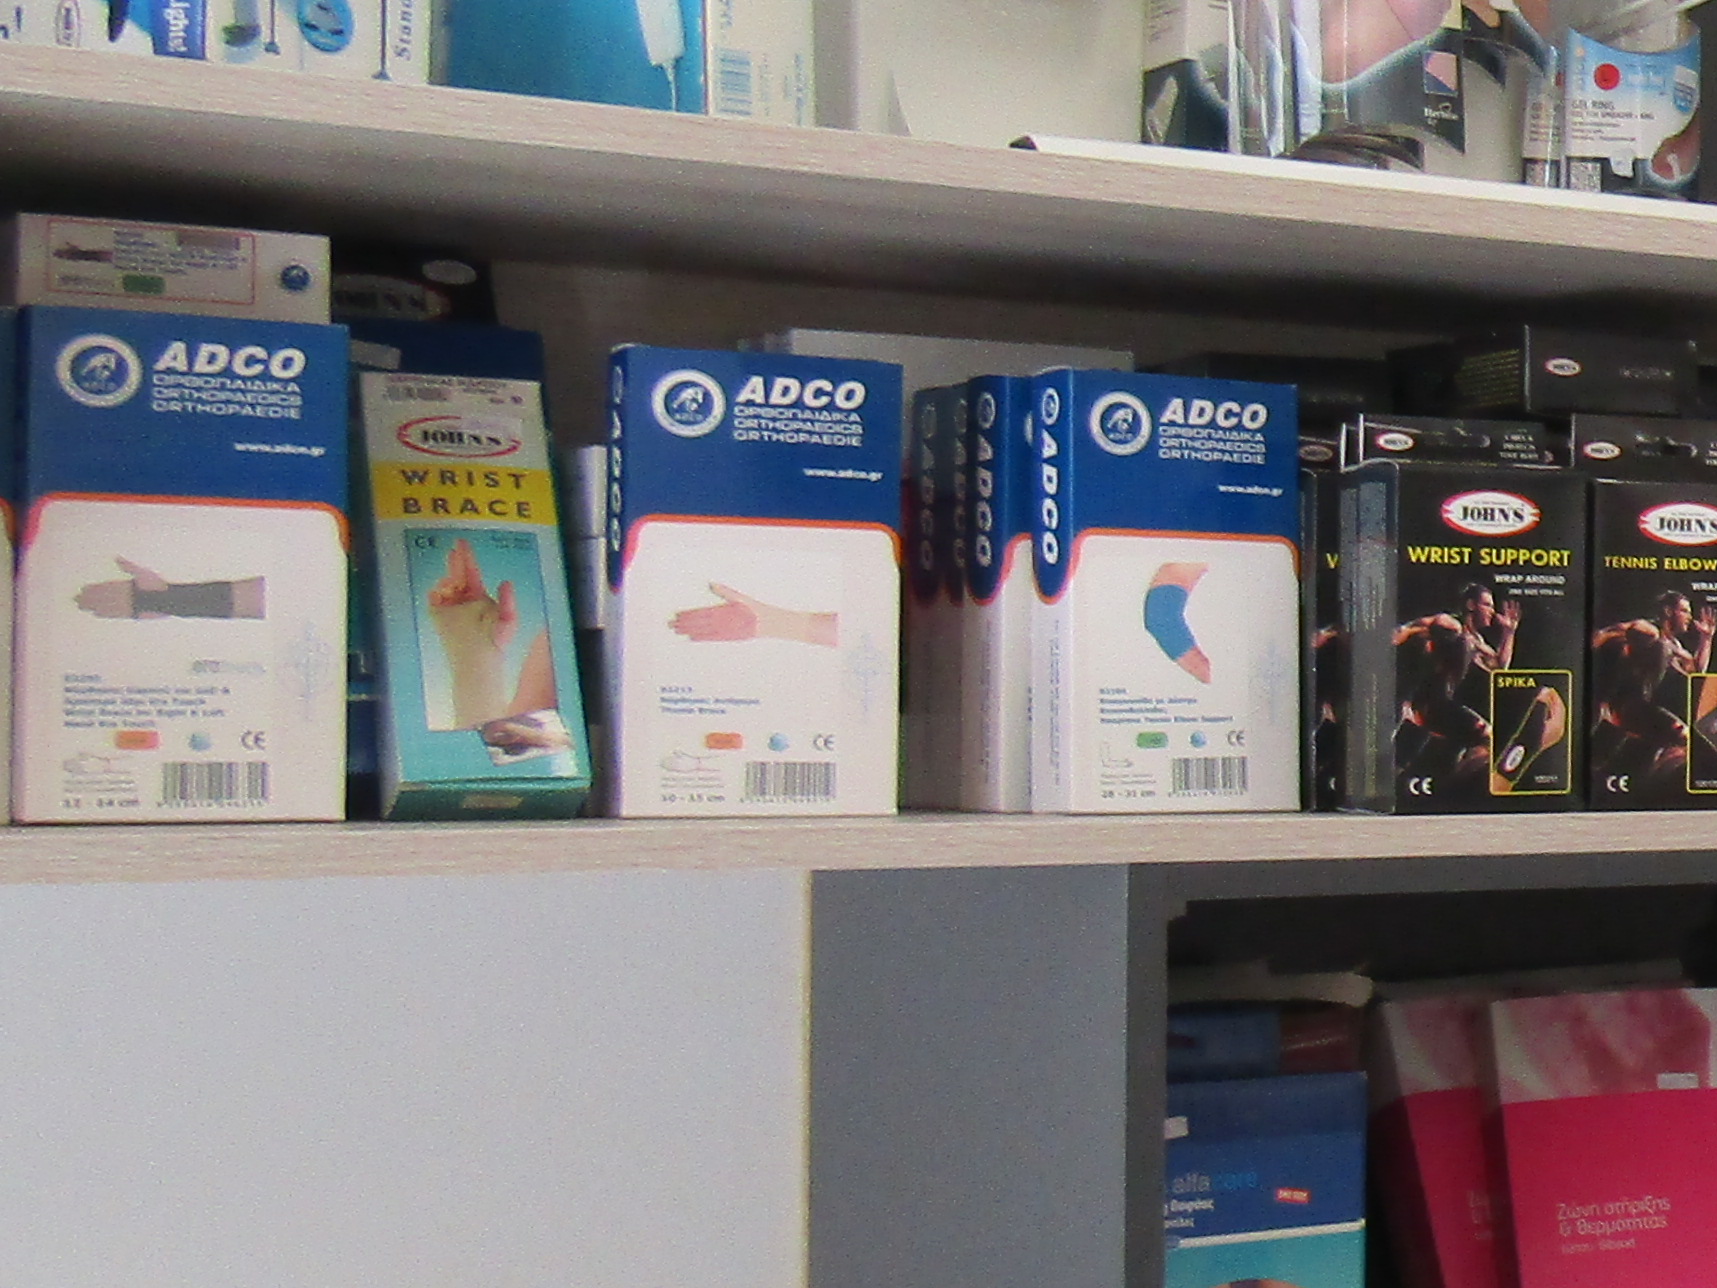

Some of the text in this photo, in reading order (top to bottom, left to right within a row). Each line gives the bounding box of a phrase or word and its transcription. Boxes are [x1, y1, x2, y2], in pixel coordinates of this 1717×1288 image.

[153, 339, 307, 380] ADCO
[152, 386, 303, 407] ORTHOPAEDICS
[734, 374, 867, 411] ADCO
[152, 400, 301, 420] ORTHOPAEDIE
[1159, 396, 1268, 430] ADCO
[402, 469, 528, 487] WRIST
[402, 498, 533, 519] BRACE
[975, 436, 994, 567] ADCO
[1040, 440, 1061, 565] ADCO
[1460, 502, 1526, 524] JOHN'S
[1407, 546, 1571, 568] WRIST SUPPORT
[1604, 555, 1658, 571] TENNIS
[1663, 557, 1717, 573] ELBOW
[1494, 573, 1567, 586] WRAP AROUND
[1497, 675, 1537, 689] SPIKA
